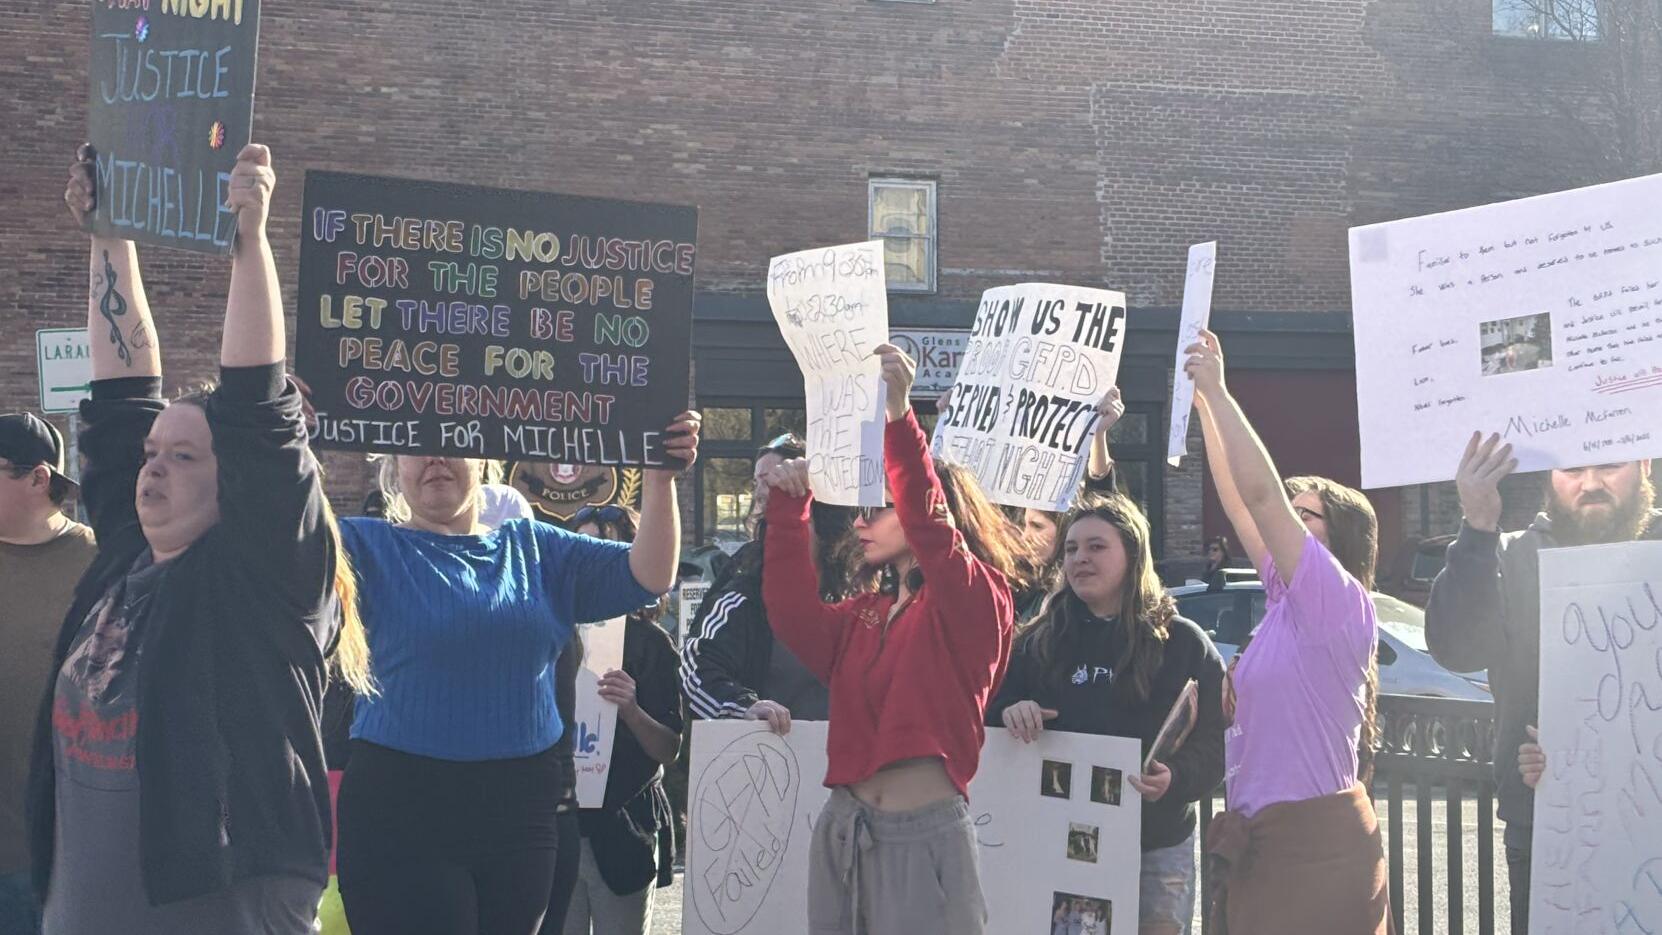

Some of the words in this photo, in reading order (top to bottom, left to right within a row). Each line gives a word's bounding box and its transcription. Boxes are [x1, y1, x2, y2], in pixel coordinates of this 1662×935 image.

[101, 33, 231, 103] JUSTICE
[95, 152, 231, 246] MICHELLE
[313, 207, 346, 242] IF
[351, 214, 464, 253] THERE
[471, 225, 505, 259] IS
[505, 228, 560, 263] NO
[562, 234, 695, 274] JUSTICE
[336, 252, 408, 289] FOR
[428, 261, 498, 297] THE
[520, 270, 654, 309] PEOPLE
[1408, 285, 1424, 296] She
[320, 295, 387, 329] LET
[396, 300, 510, 337] THERE
[530, 309, 575, 342] BE
[595, 314, 650, 347] NO
[922, 336, 960, 346] Glens
[972, 296, 1025, 338] SHOW
[1031, 299, 1065, 336] US
[1072, 301, 1126, 353] THE
[45, 344, 90, 360] LARA
[339, 337, 460, 376] PEACE
[484, 346, 555, 380] FOR
[579, 353, 650, 386] THE
[789, 327, 875, 370] WHERE
[922, 346, 966, 368] Kar
[818, 373, 869, 415] WAS
[922, 369, 958, 378] Aca
[345, 376, 616, 424] GOVERNMENT
[307, 412, 421, 447] JUSTICE
[440, 421, 485, 454] FOR
[503, 425, 664, 466] MICHELLE
[1504, 414, 1572, 439] Michelle
[542, 488, 590, 501] POLICE
[700, 743, 790, 851] GFPD
